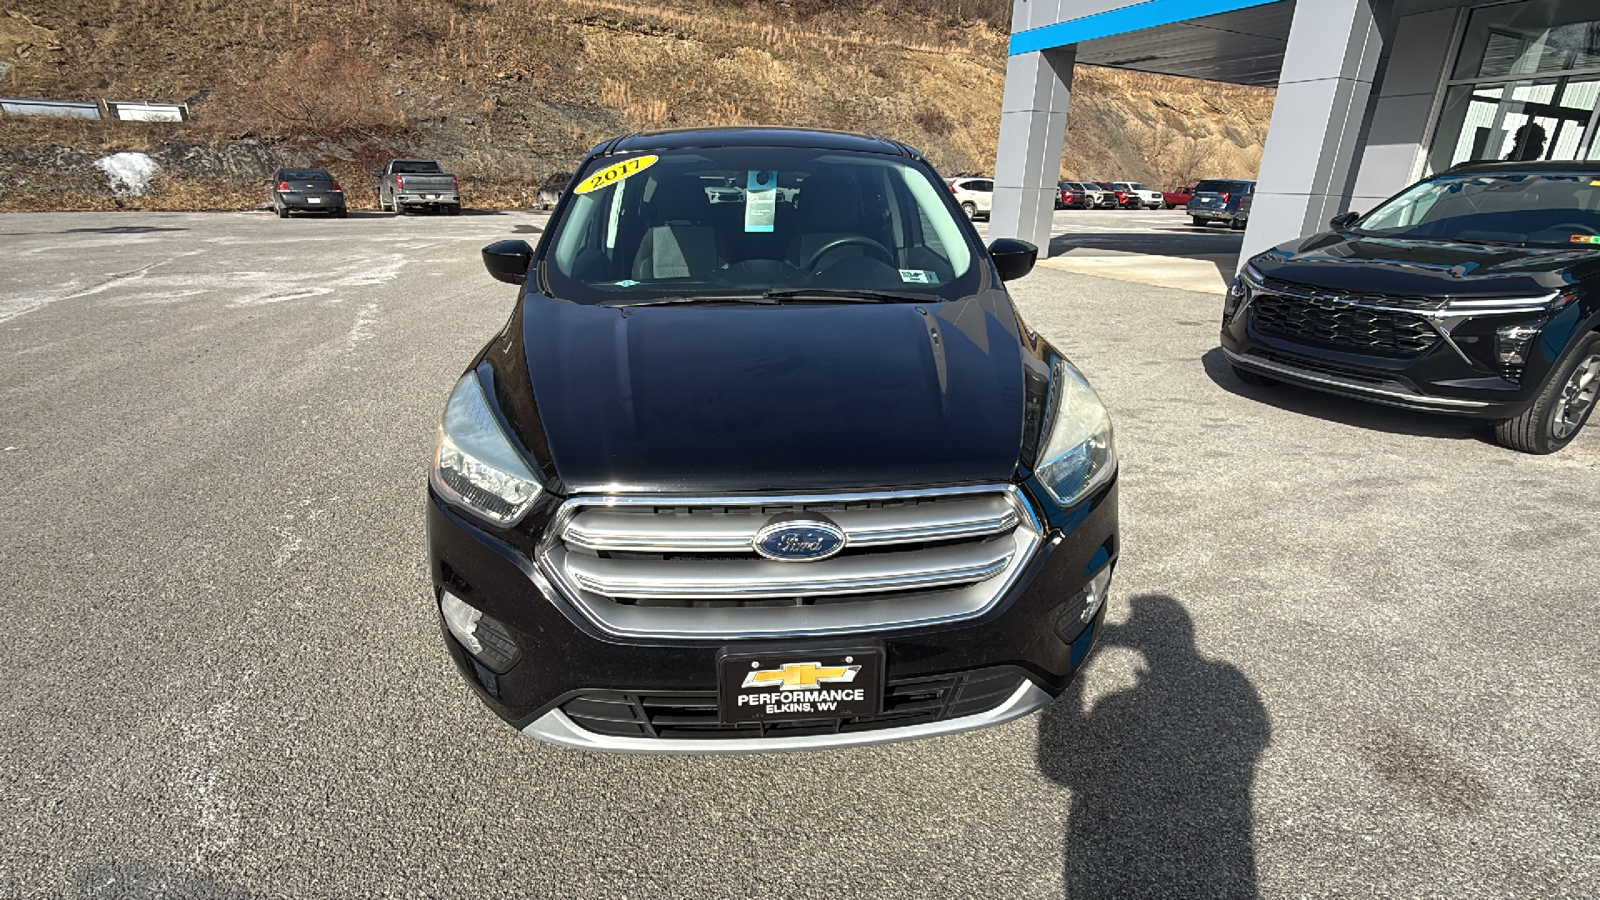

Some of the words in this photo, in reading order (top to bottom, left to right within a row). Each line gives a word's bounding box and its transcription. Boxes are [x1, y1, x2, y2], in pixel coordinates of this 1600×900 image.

[590, 159, 640, 189] 2017
[776, 532, 823, 552] Ford
[737, 688, 865, 706] PERFORMANCE
[766, 702, 814, 714] ELKINS,
[817, 701, 838, 711] WV
